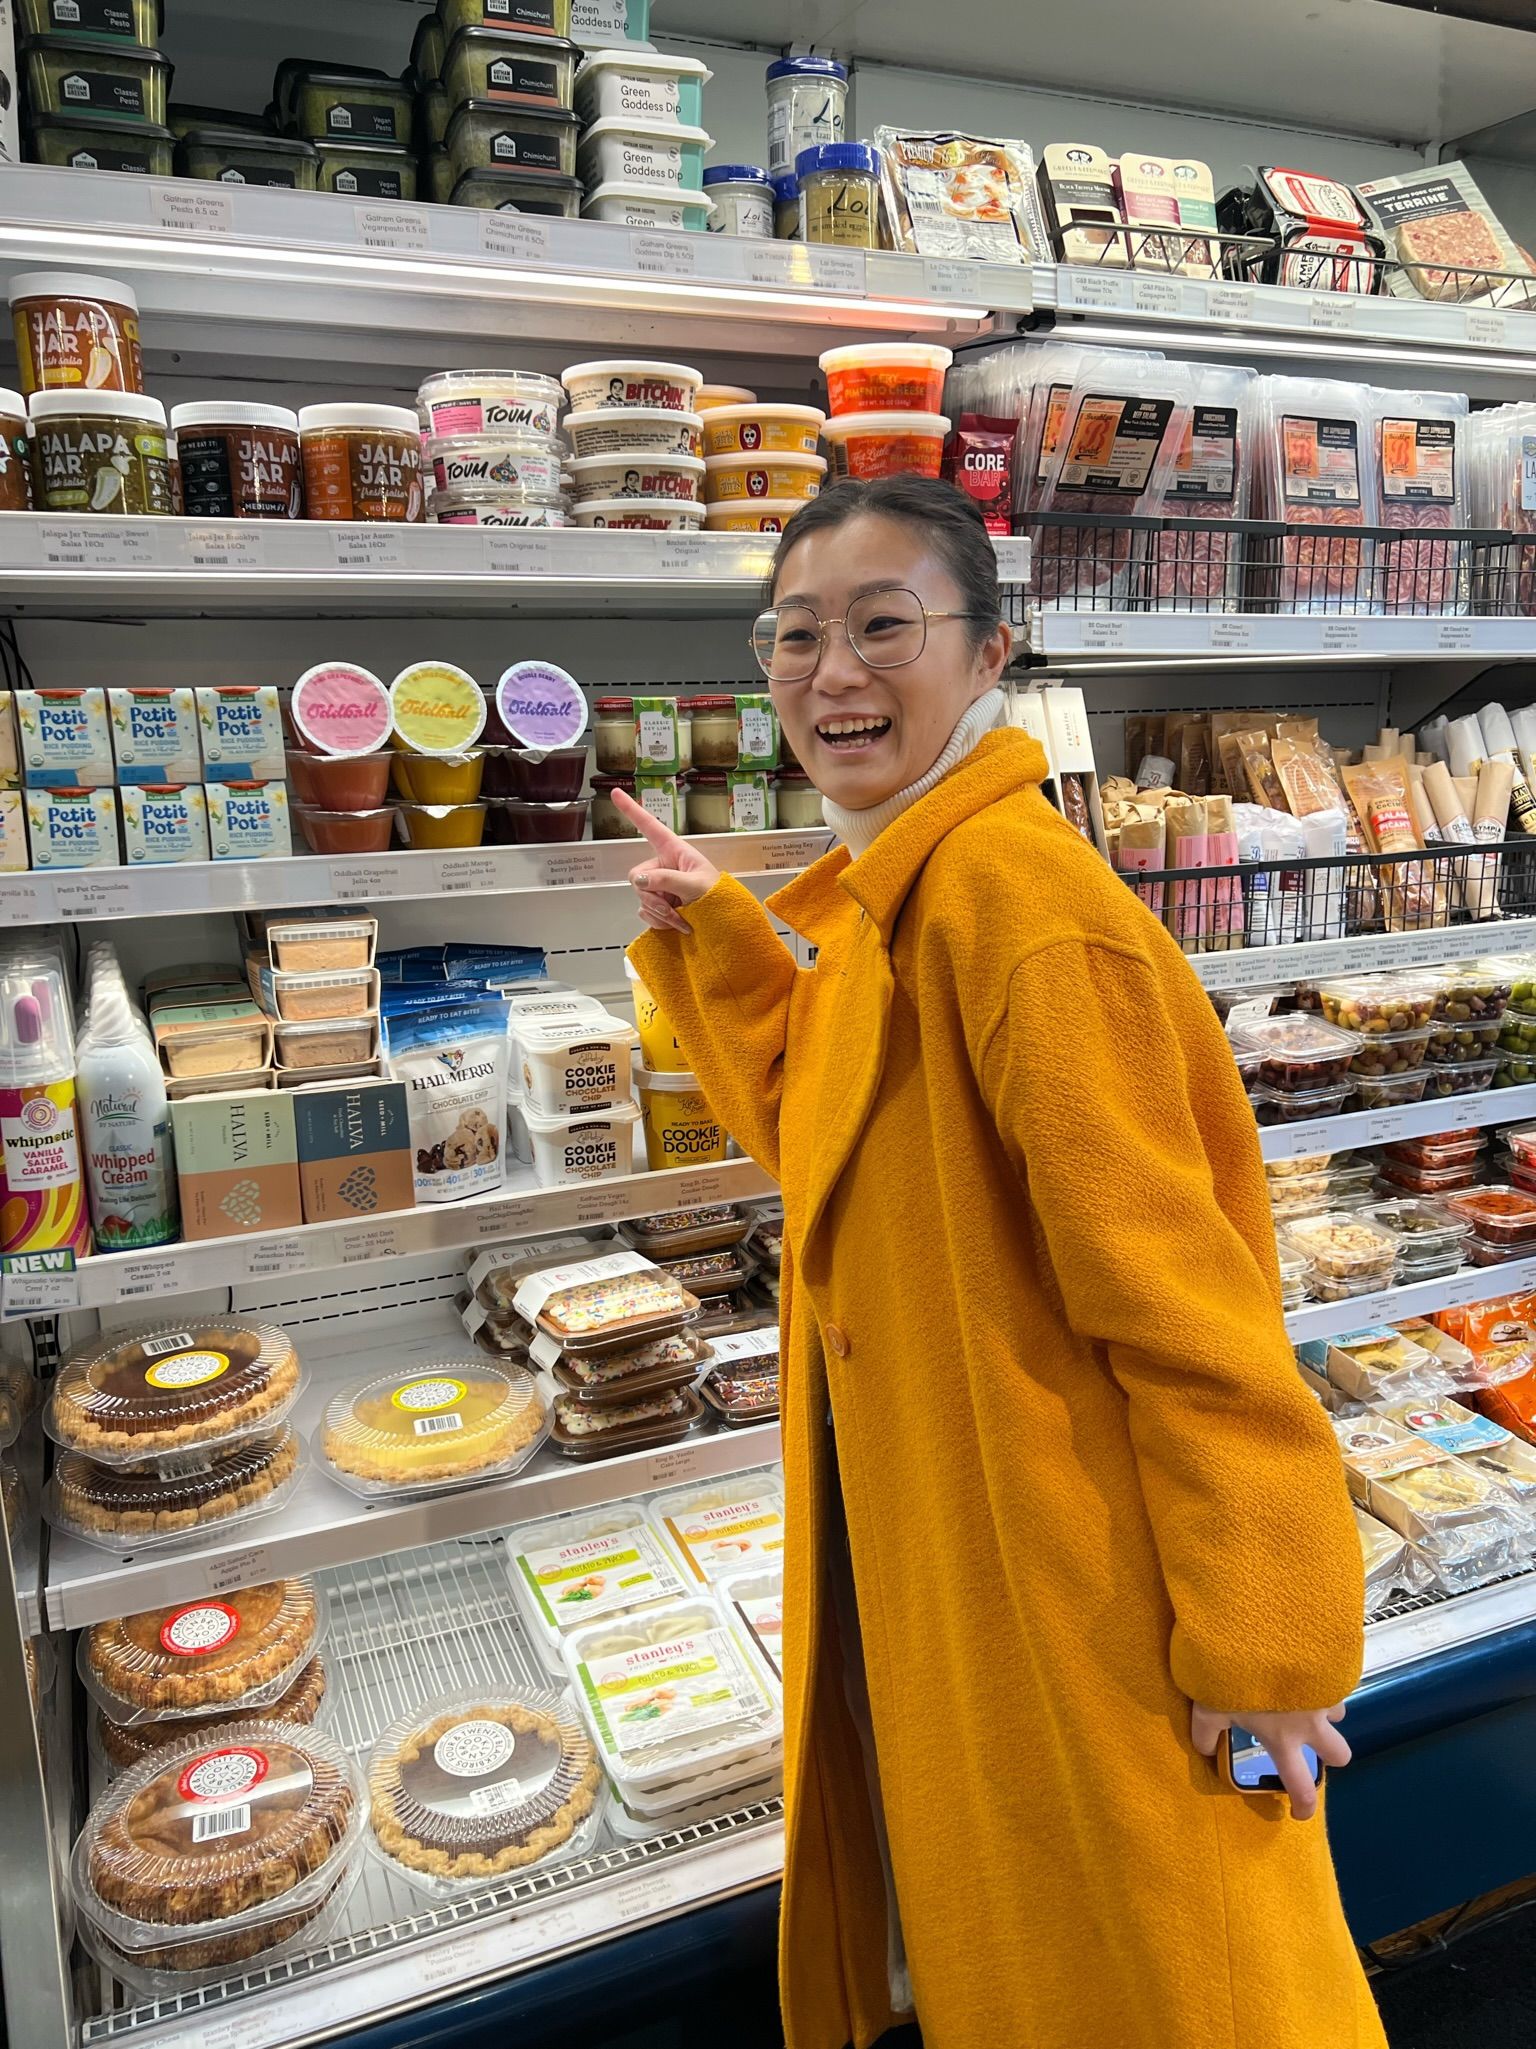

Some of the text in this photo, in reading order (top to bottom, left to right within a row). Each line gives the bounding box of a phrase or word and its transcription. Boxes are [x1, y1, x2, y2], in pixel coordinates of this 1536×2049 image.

[104, 8, 129, 19] Classic
[571, 2, 599, 15] Green
[110, 18, 130, 28] Pesto
[571, 15, 629, 31] Goddess Dip
[520, 78, 554, 90] Chimichurri
[114, 88, 138, 98] Classic
[621, 85, 650, 98] Green
[120, 96, 140, 106] Pesto
[622, 98, 682, 114] Goddess Dip
[373, 116, 392, 125] Vegan
[375, 124, 392, 132] Pesto
[522, 151, 557, 162] Chimichurri
[623, 151, 653, 164] Green
[121, 163, 146, 173] Classic
[623, 164, 684, 182] Goddess Dip
[378, 180, 397, 189] Vegan
[381, 188, 398, 196] Pesto
[164, 194, 224, 208] Gotham Greens
[828, 185, 868, 215] Loi
[1384, 192, 1448, 212] TERRINE
[170, 204, 194, 214] Pesto
[366, 214, 422, 224] Gotham Greens
[626, 215, 655, 226] Green
[489, 218, 542, 236] Gotham Greens
[33, 310, 120, 337] JALAPA
[35, 336, 80, 353] JAR
[626, 384, 686, 402] BITCHIN'
[844, 385, 926, 398] PIMENTO CHEESE
[486, 405, 532, 426] TOUM
[41, 433, 130, 454] JALAPA
[43, 455, 82, 476] JAR
[965, 453, 1005, 472] CORE
[240, 464, 284, 484] JAR
[360, 466, 402, 486] JAR
[446, 462, 489, 480] TOUM
[970, 471, 1001, 486] BAR
[266, 486, 288, 496] salsa
[246, 503, 276, 511] MEDIUM
[42, 530, 68, 540] Jalapa
[225, 532, 260, 542] Brooklyn
[338, 534, 360, 542] Jalapa
[490, 541, 534, 551] Toum Original
[39, 708, 88, 725] Petit
[130, 706, 176, 722] Petit
[216, 705, 261, 720] Petit
[42, 725, 76, 742] Pot
[132, 722, 165, 738] Pot
[218, 720, 250, 736] Pot
[60, 741, 92, 749] PUDDING
[150, 738, 180, 746] PUDDING
[236, 736, 266, 744] PUDDING
[143, 804, 188, 820] Petit
[226, 800, 270, 815] Petit
[48, 808, 96, 824] Petit
[228, 815, 258, 830] Pot
[50, 824, 84, 839] Pot
[144, 820, 176, 835] Pot
[442, 860, 492, 870] Oddball Mango
[441, 870, 468, 878] Coconut
[57, 884, 129, 894] Petit Chocolate
[418, 1008, 480, 1024] READY TO EAT BITES
[412, 1061, 495, 1092] HAIL MERRY
[565, 1064, 616, 1078] COOKIE
[565, 1076, 616, 1089] DOUGH
[566, 1085, 616, 1096] CHOCOLATE
[582, 1093, 602, 1102] CHIP
[90, 1094, 137, 1118] Natural
[432, 1090, 488, 1110] CHOCOLATE CHIP
[346, 1093, 364, 1150] HALVA
[6, 1130, 74, 1148] whipnotic
[230, 1104, 248, 1162] HALVA
[662, 1125, 719, 1141] COOKIE
[564, 1141, 616, 1156] COOKIE
[664, 1137, 720, 1154] DOUGH
[23, 1147, 64, 1159] VANILLA
[92, 1148, 155, 1172] Whipped
[564, 1153, 616, 1166] DOUGH
[28, 1155, 62, 1168] SALTED
[565, 1162, 616, 1174] CHOCOLATE
[22, 1162, 68, 1176] CARAMEL
[582, 1171, 602, 1179] CHIP
[102, 1170, 148, 1184] Cream
[702, 1184, 719, 1193] Dough
[380, 1230, 394, 1238] Dark
[376, 1238, 394, 1246] Halva
[10, 1252, 66, 1274] NEW
[142, 1261, 175, 1272] Whipped
[130, 1272, 156, 1281] Cream
[703, 1501, 760, 1522] stanley's
[559, 1536, 618, 1560] stanley's
[220, 1566, 239, 1576] Apple
[204, 1609, 226, 1622] FOUR
[626, 1640, 695, 1666] stanley's
[460, 1726, 499, 1740] TWENTY
